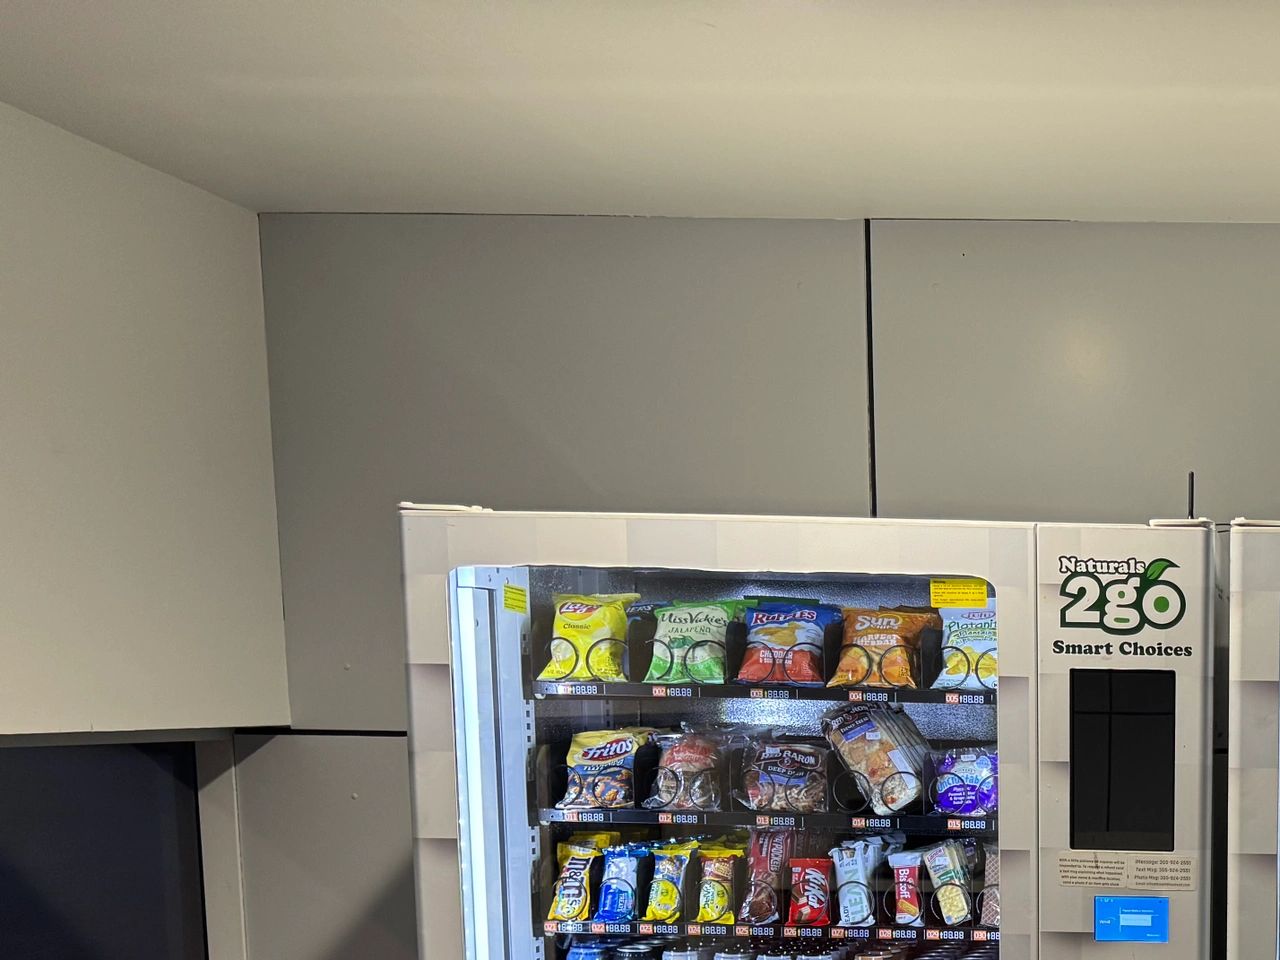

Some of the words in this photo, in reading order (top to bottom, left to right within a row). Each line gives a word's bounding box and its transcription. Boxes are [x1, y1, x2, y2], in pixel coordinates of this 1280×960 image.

[1058, 556, 1145, 575] Naturals
[661, 612, 687, 625] Miss
[687, 612, 728, 628] Vickie's
[563, 622, 590, 630] Classic
[1052, 640, 1113, 656] Smart
[1118, 641, 1193, 657] Choices
[849, 692, 862, 701] 004
[946, 695, 958, 703] 005
[585, 737, 632, 759] Fritos
[783, 749, 816, 764] BARON
[659, 815, 672, 823] 012
[757, 817, 769, 825] 013
[852, 819, 864, 827] 014
[948, 821, 961, 829] 015
